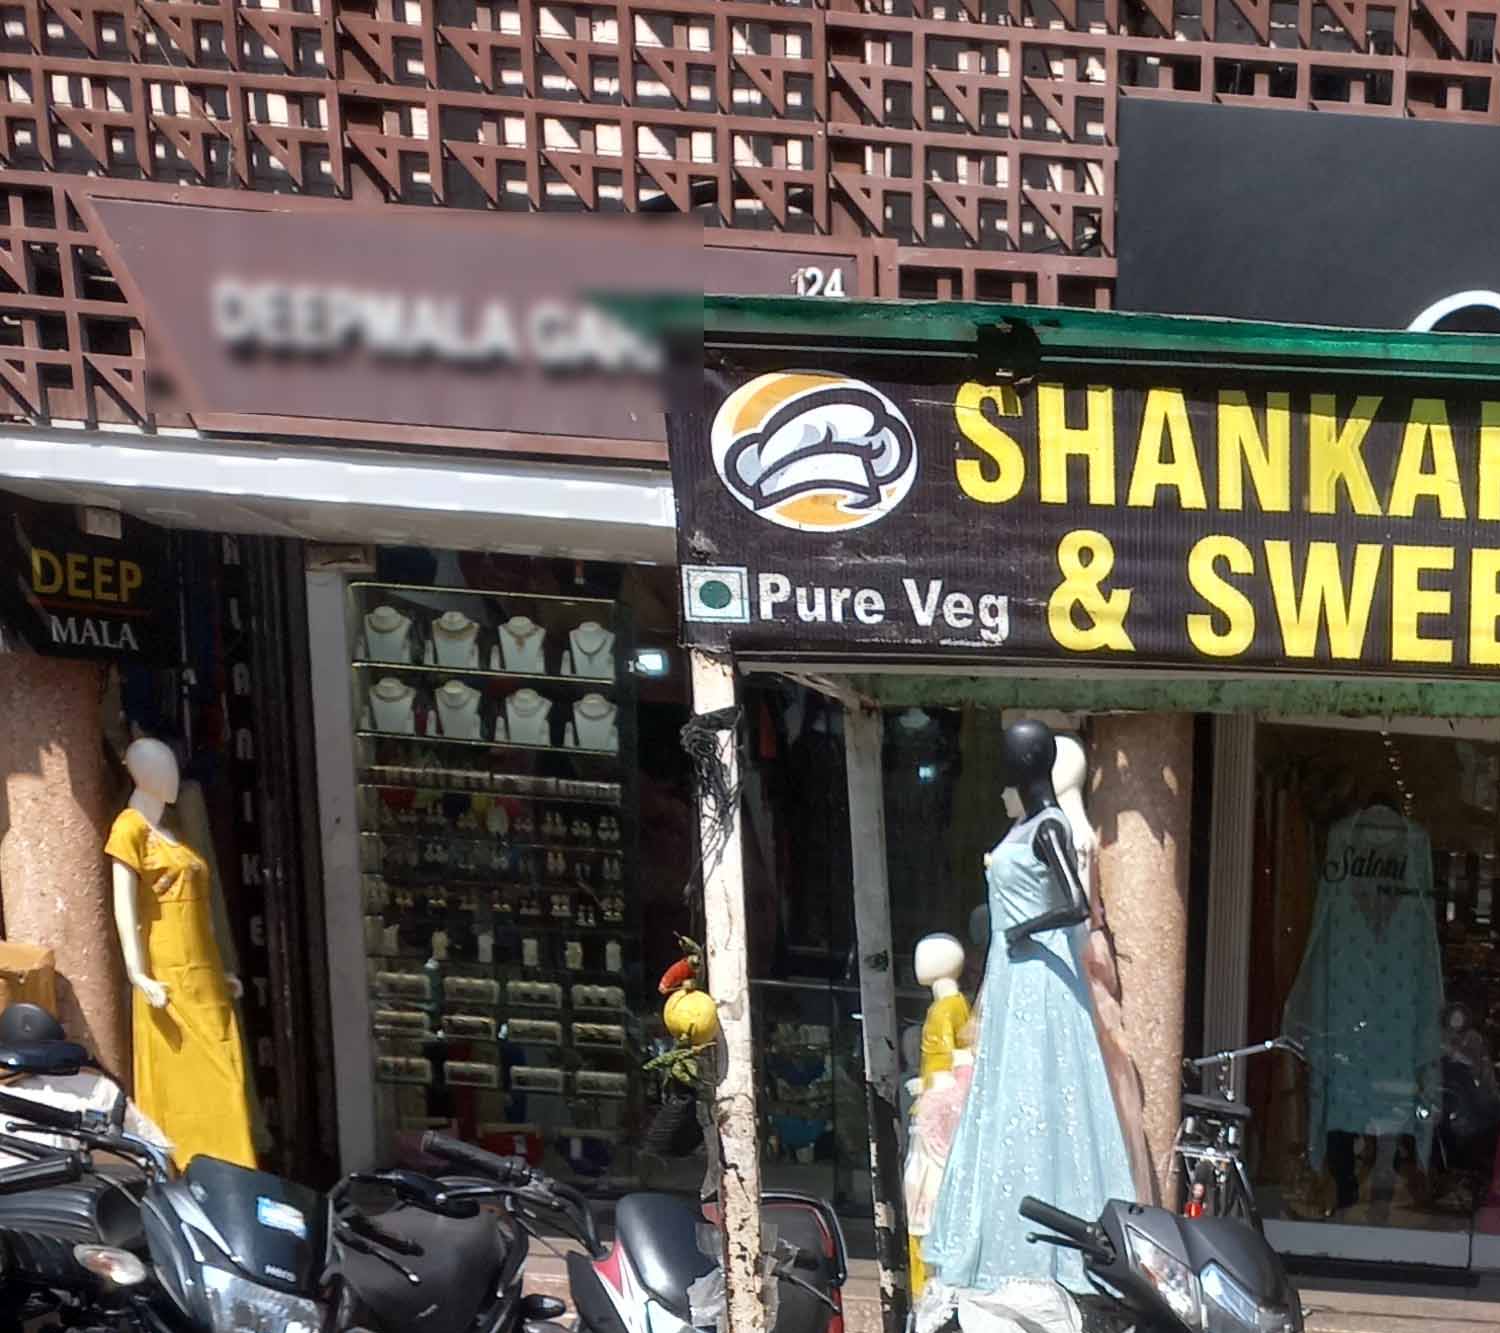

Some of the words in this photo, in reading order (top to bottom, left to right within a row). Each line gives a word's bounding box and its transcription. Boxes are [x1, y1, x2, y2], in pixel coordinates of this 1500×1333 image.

[31, 547, 143, 602] DEEP
[1047, 528, 1136, 652] &
[49, 614, 139, 651] MALA
[757, 572, 886, 627] Pure
[902, 578, 1010, 644] Veg
